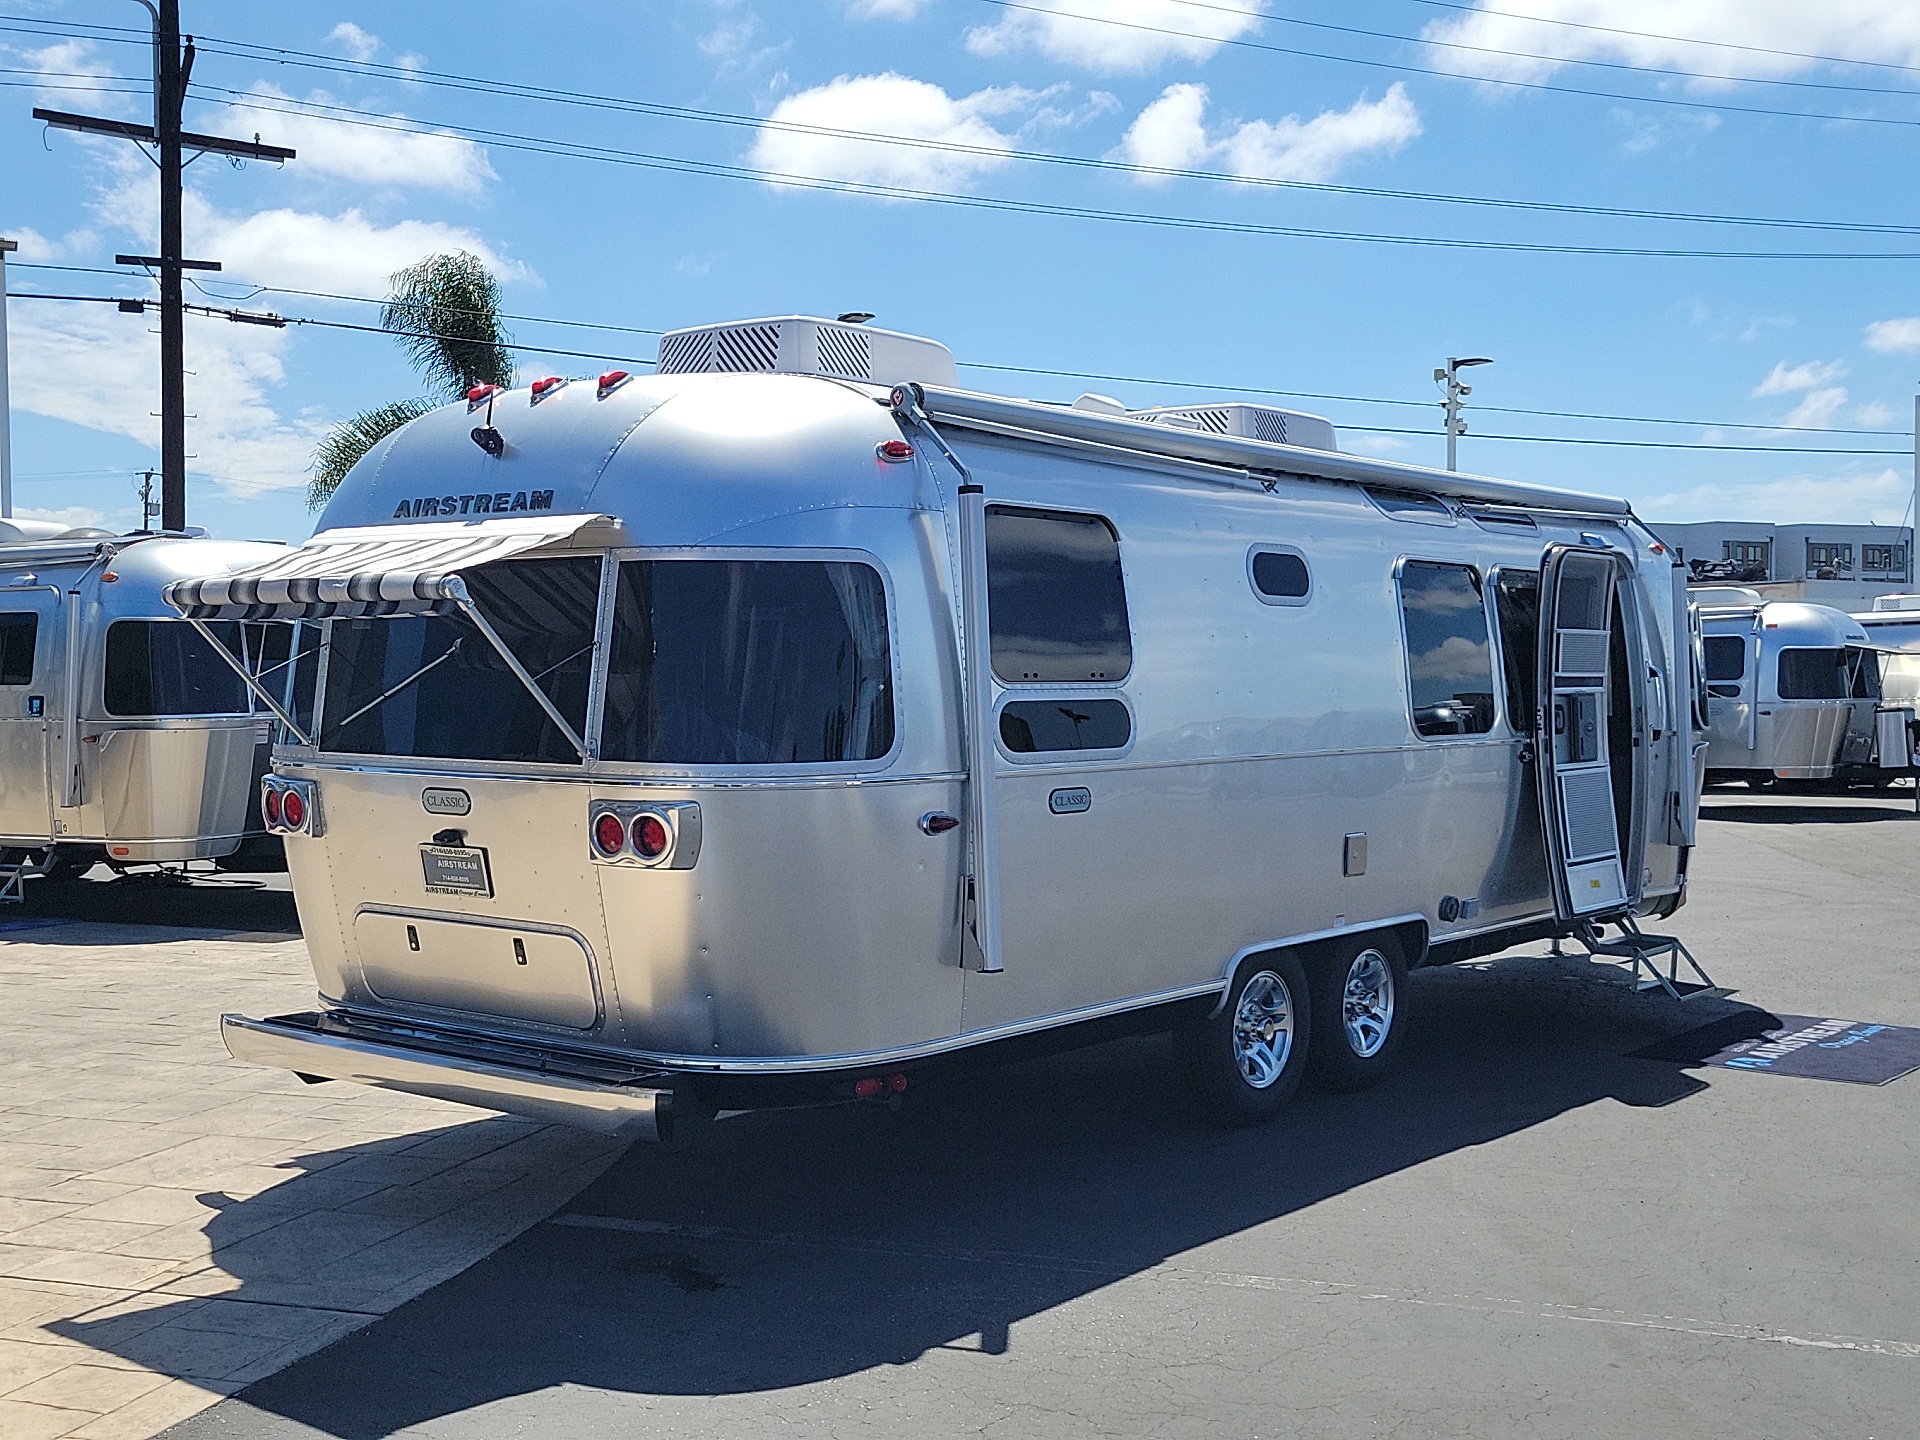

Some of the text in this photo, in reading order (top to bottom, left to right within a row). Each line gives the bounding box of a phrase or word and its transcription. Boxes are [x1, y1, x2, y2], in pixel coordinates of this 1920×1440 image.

[393, 490, 554, 518] AIRSTREAM
[427, 795, 465, 808] CLASSIC
[1054, 794, 1088, 807] CLASSIC
[438, 859, 478, 870] AIRSTREAM
[425, 887, 459, 895] AIRSTREAM
[1748, 1019, 1858, 1059] AIRSTREAM
